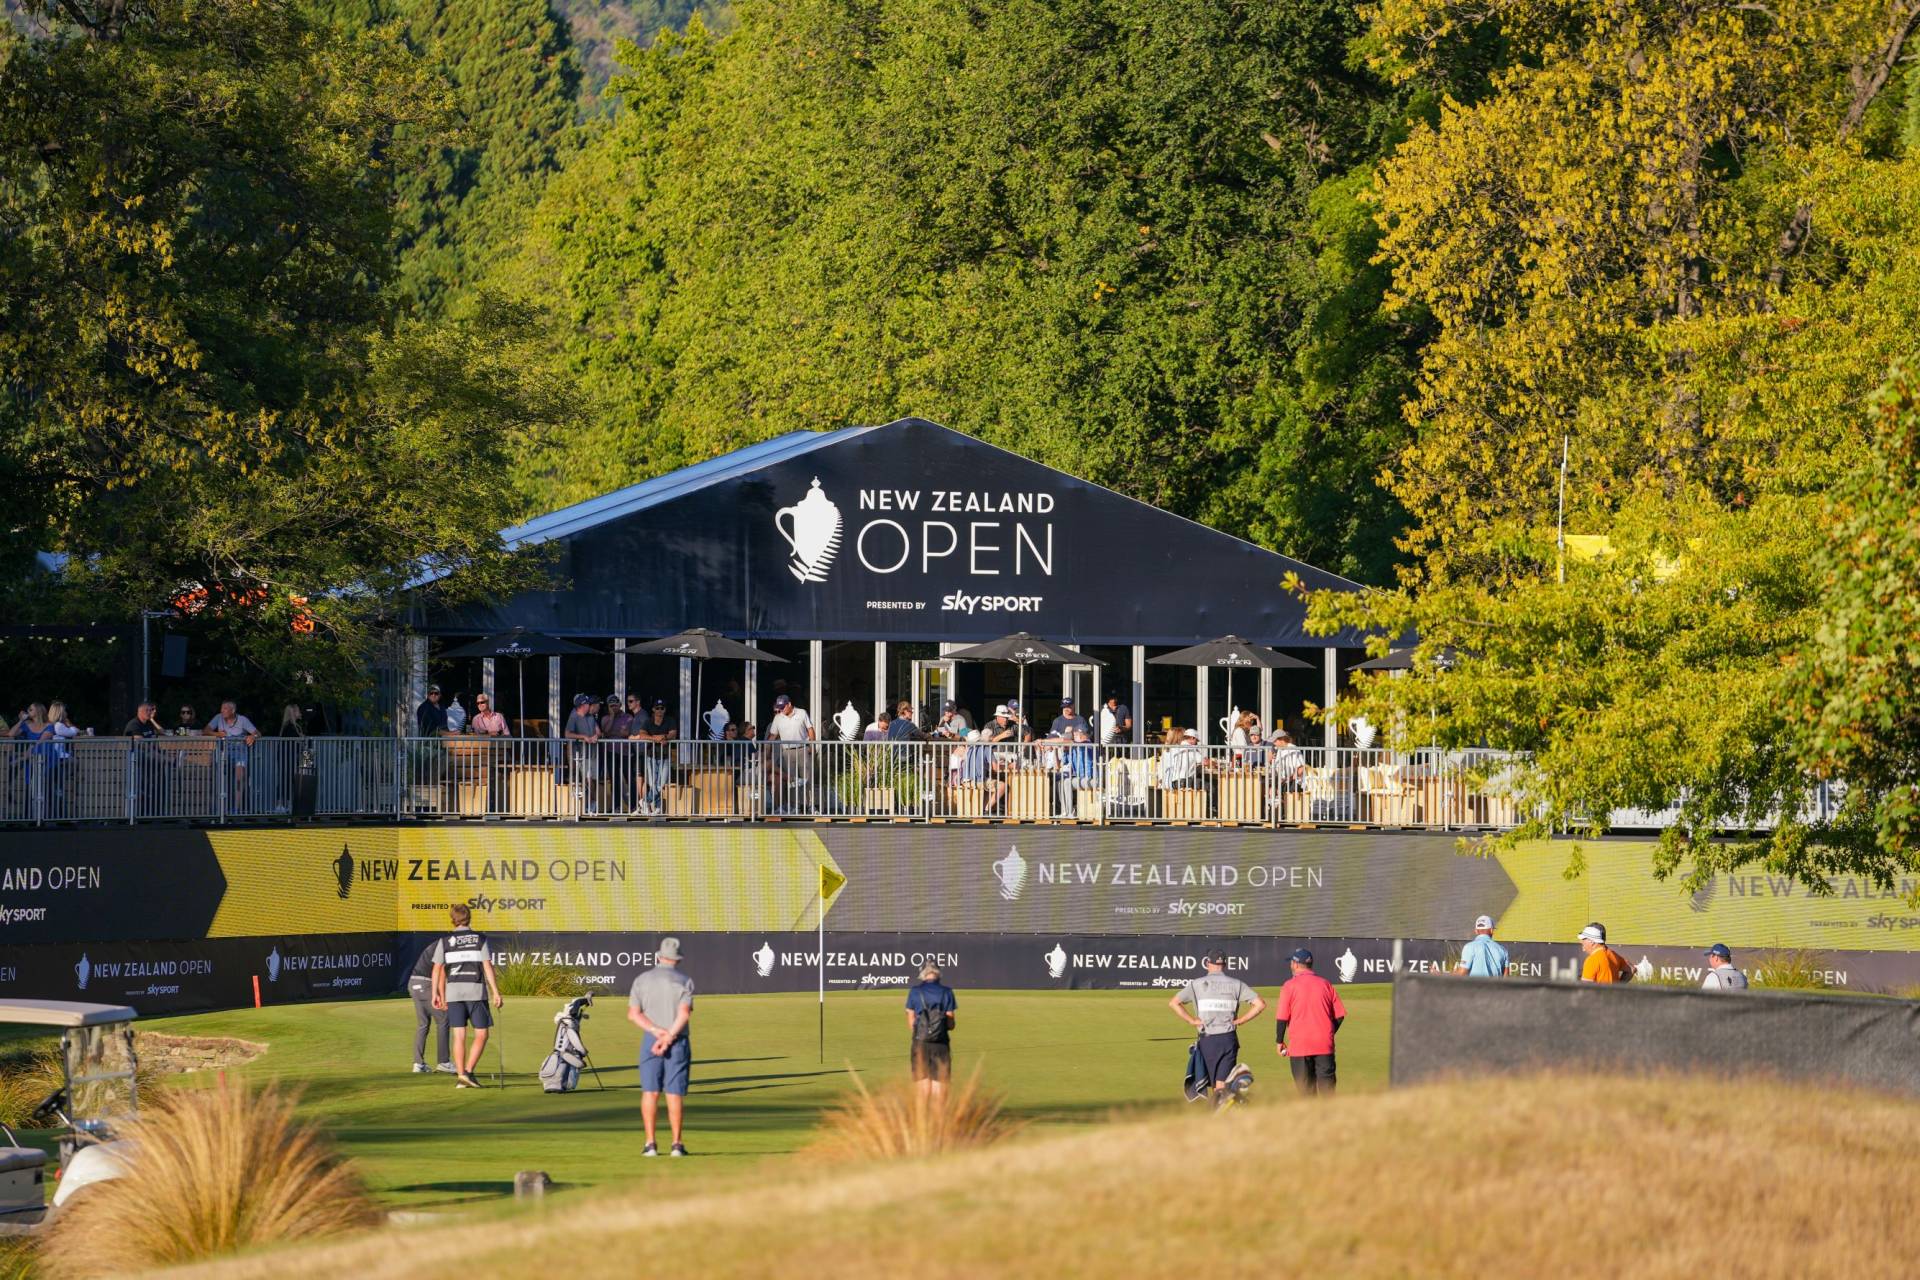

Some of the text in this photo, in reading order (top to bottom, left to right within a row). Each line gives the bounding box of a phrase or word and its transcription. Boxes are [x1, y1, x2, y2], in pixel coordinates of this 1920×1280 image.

[860, 489, 1055, 513] NEW ZEALAND
[857, 519, 1053, 576] OPEN
[866, 601, 913, 610] PRESENTED
[916, 602, 926, 610] BY
[48, 866, 100, 890] OPEN
[360, 859, 626, 881] NEW ZEALAND OPEN
[1039, 863, 1323, 888] NEW ZEALAND OPEN
[1728, 875, 1794, 897] NEW
[94, 959, 212, 978] NEW ZEALAND OPEN
[283, 953, 392, 970] NEW ZEALAND OPEN
[530, 952, 612, 967] ZEALAND
[781, 952, 821, 966] NEW
[826, 953, 905, 967] ZEALAND
[1073, 954, 1112, 968] NEW
[1117, 954, 1197, 970] ZEALAND
[1508, 962, 1542, 977] PEN
[1660, 967, 1702, 981] NEW
